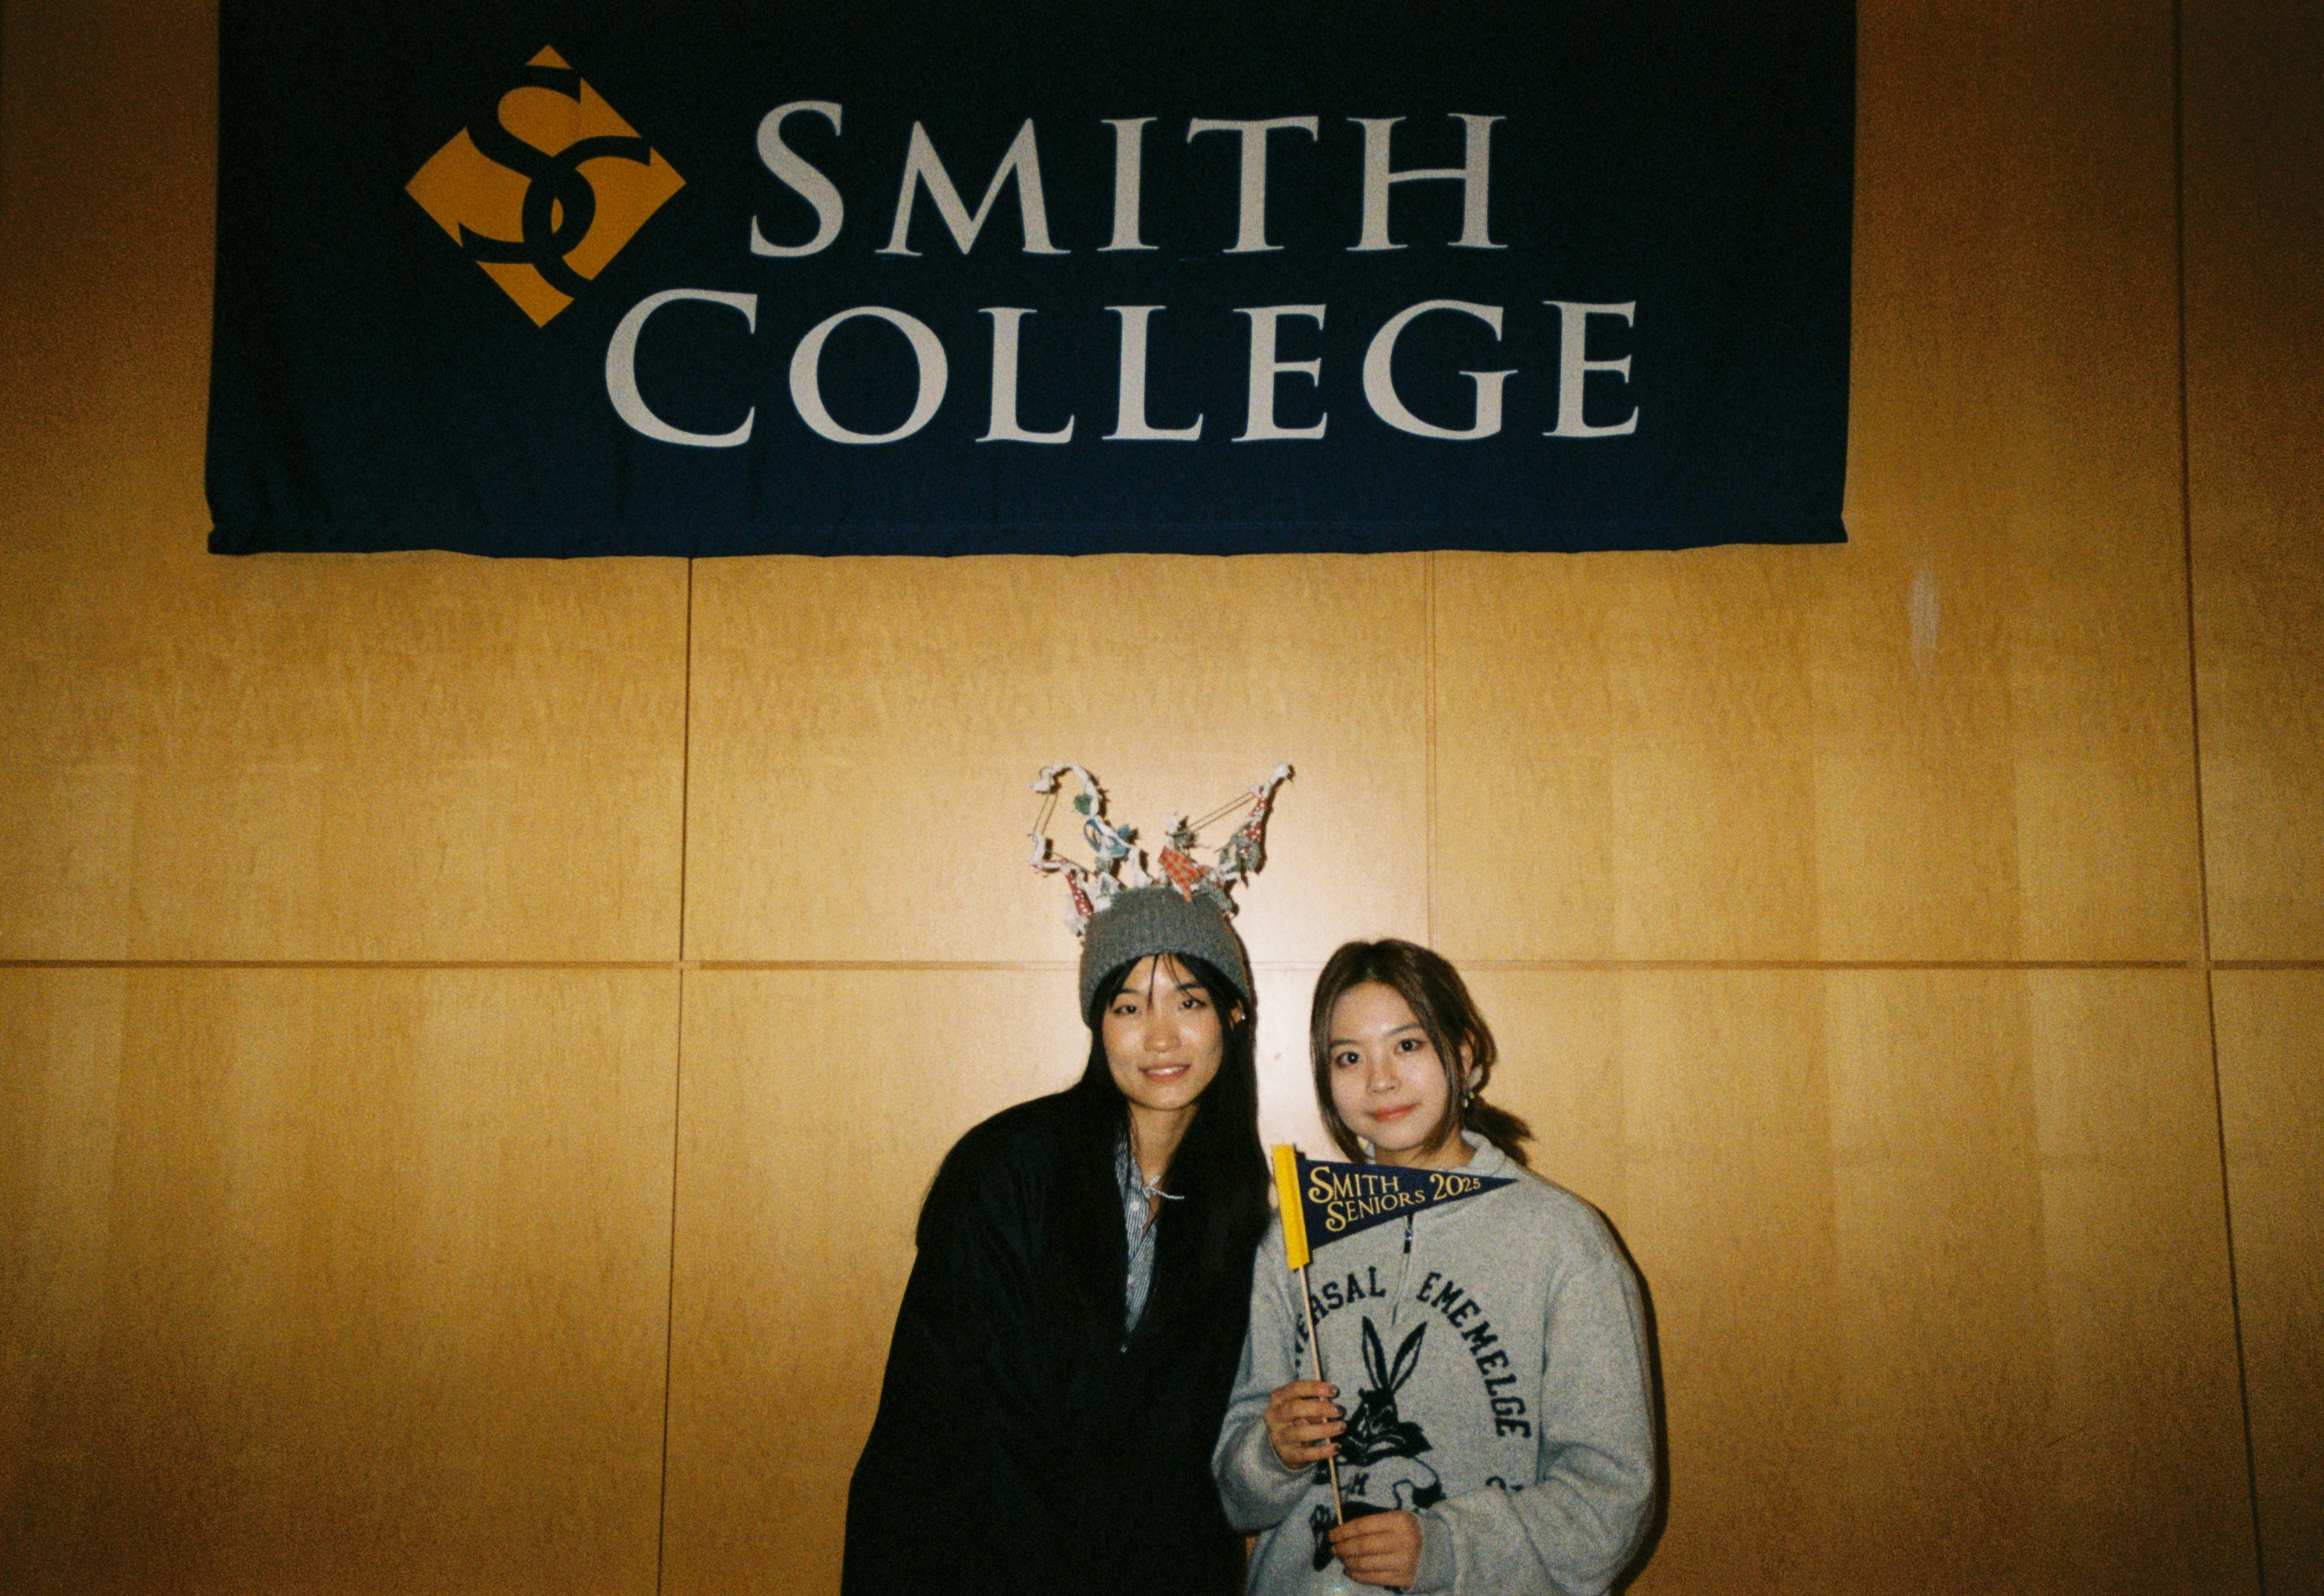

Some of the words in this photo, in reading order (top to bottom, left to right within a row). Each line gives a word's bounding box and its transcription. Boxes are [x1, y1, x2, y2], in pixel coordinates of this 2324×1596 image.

[749, 100, 1509, 258] SMITH
[604, 288, 1640, 449] COLLEGE
[1308, 1166, 1399, 1203] SMITH
[1325, 1190, 1426, 1232] SENIORS
[1430, 1174, 1481, 1201] 2025
